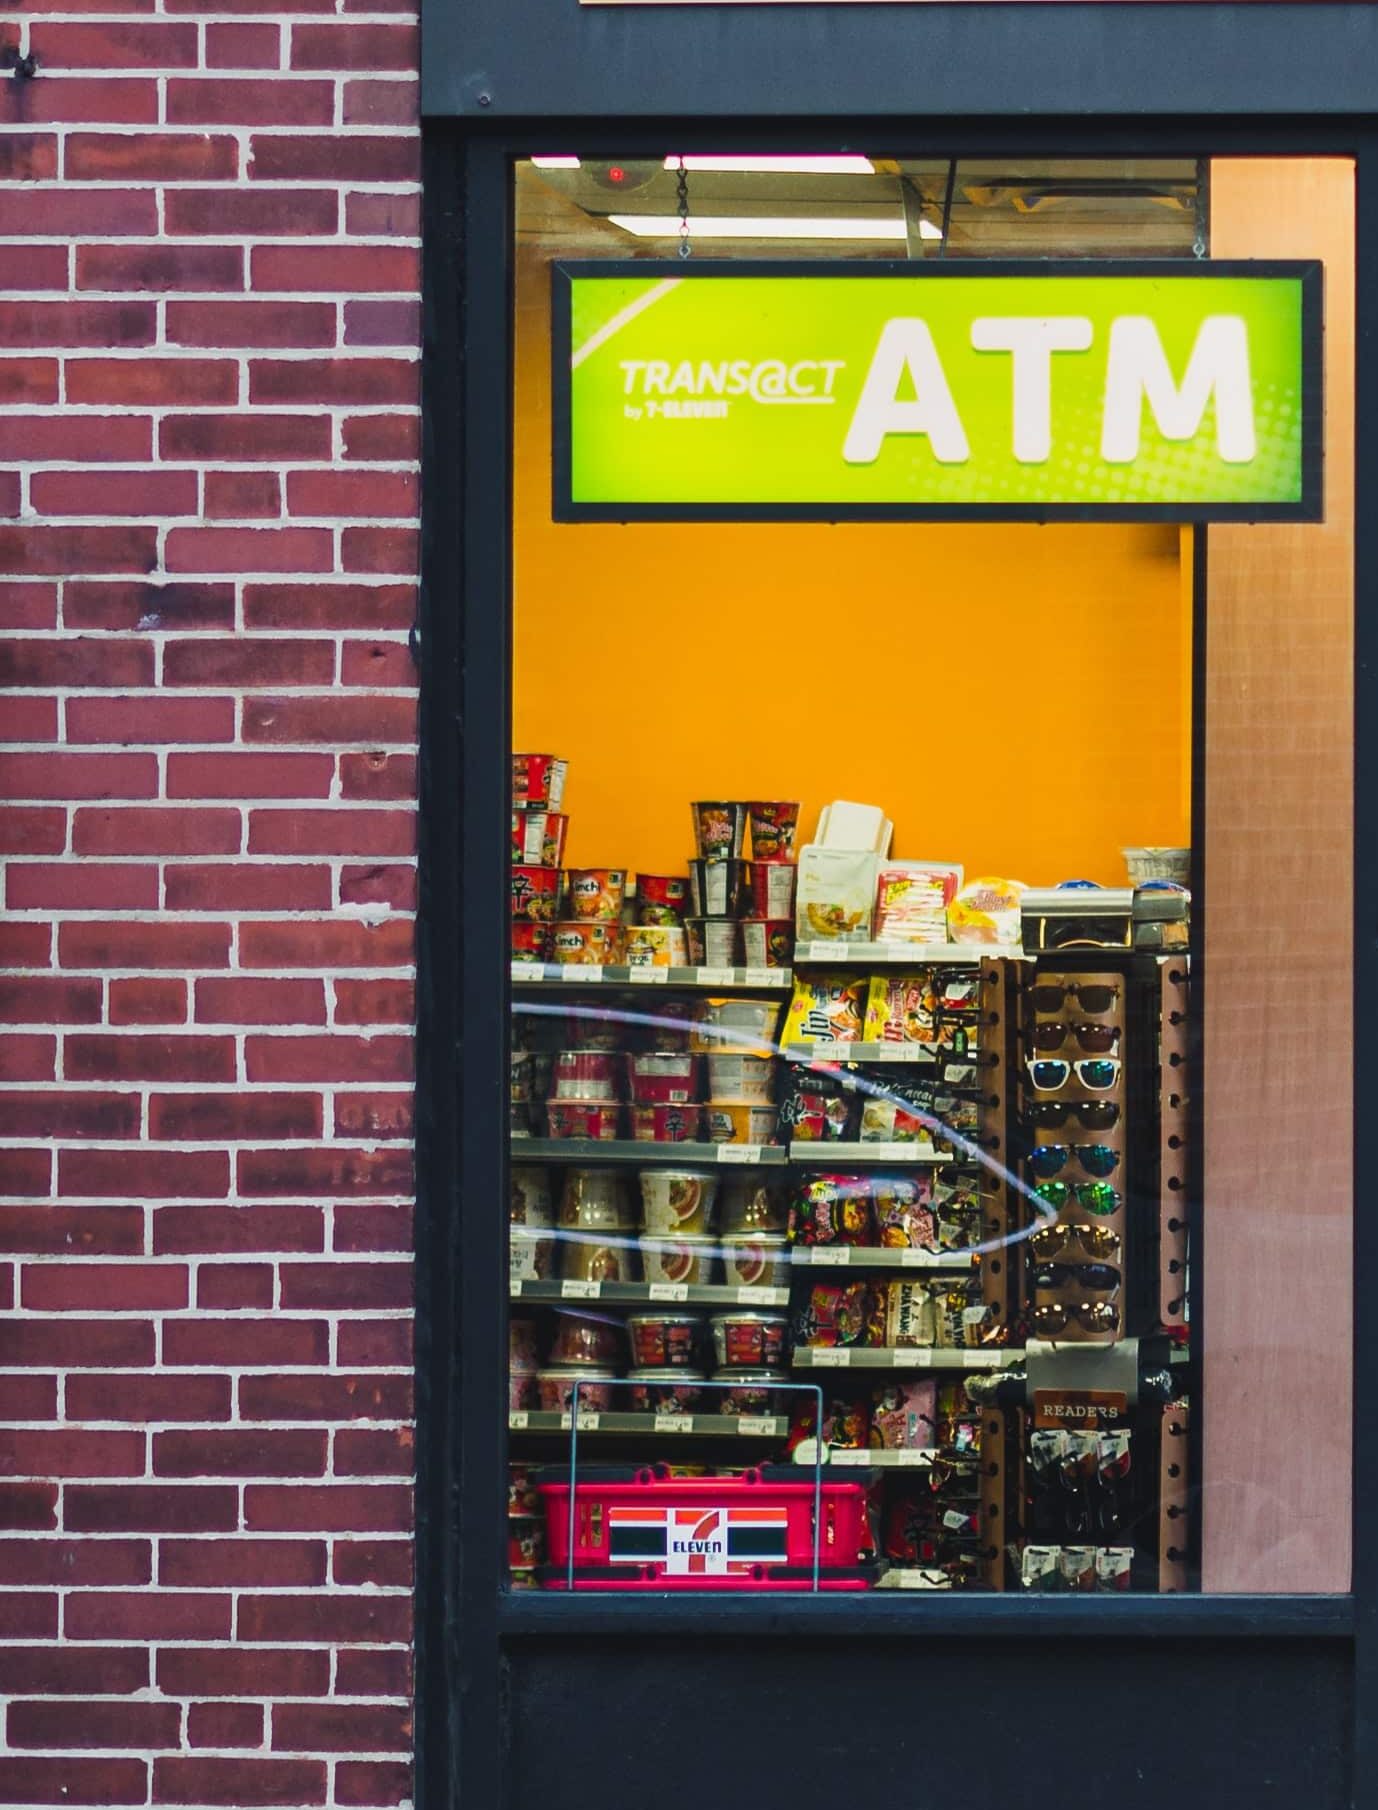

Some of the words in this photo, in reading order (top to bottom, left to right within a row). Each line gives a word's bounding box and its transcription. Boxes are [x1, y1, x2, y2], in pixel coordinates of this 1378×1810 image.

[619, 359, 846, 404] TRANS@CT
[842, 316, 1257, 464] ATM
[624, 404, 643, 421] by
[1043, 1405, 1119, 1418] READERS
